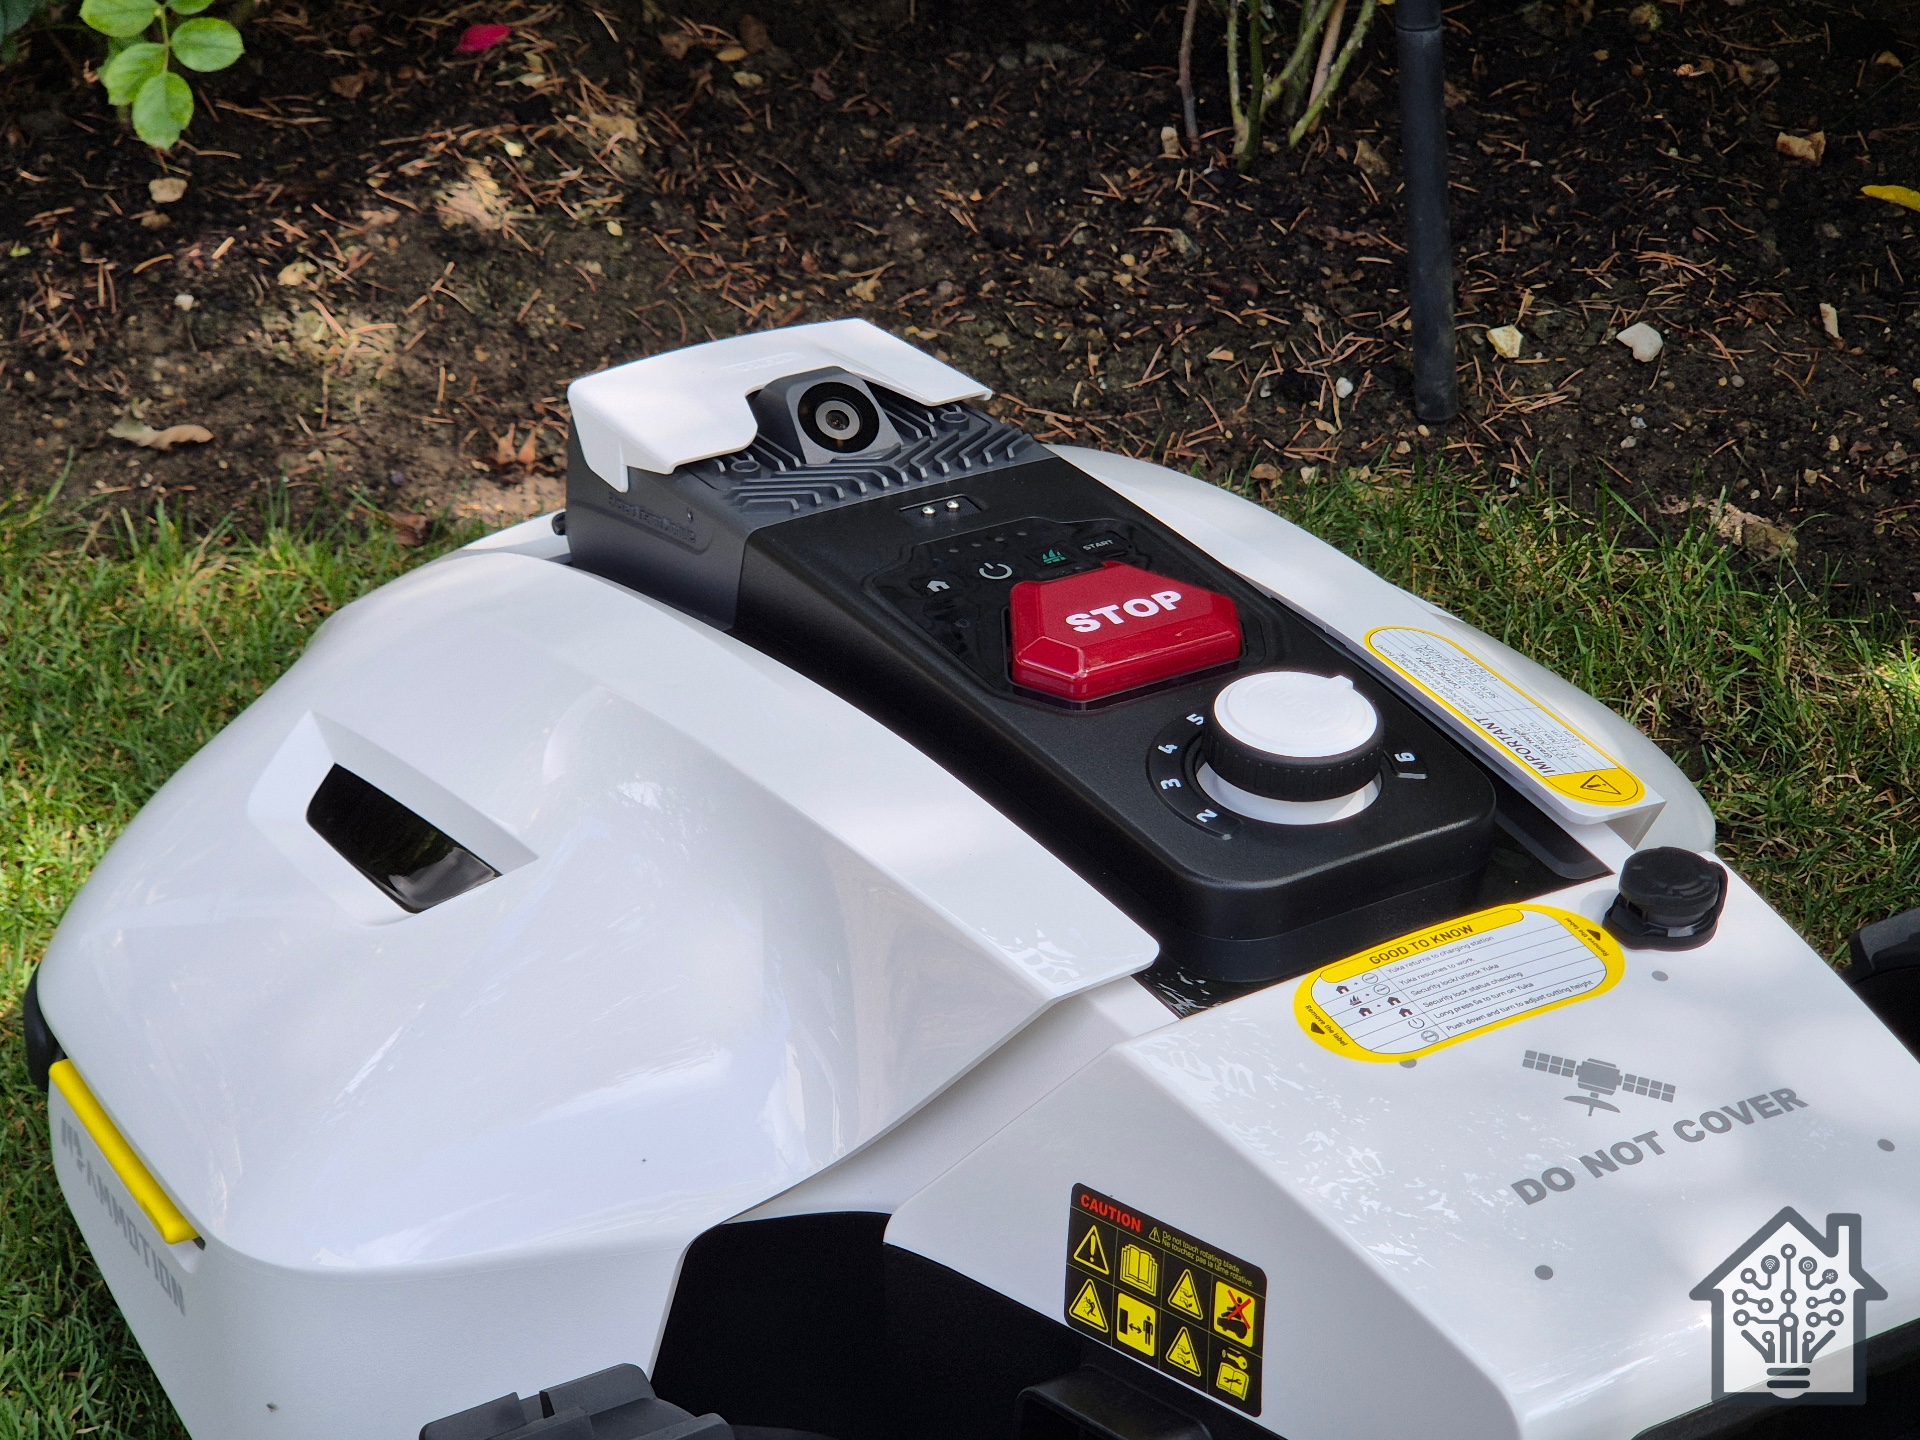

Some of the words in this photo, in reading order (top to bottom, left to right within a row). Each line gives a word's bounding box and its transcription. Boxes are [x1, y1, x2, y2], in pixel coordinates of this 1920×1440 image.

[1082, 538, 1114, 552] START
[1065, 589, 1182, 634] STOP
[1415, 657, 1438, 672] Height
[1436, 671, 1462, 689] Cutting
[1186, 713, 1205, 726] 5
[1510, 727, 1535, 744] Height
[1157, 743, 1178, 755] 4
[1473, 717, 1556, 774] IMPORTANT
[1533, 744, 1553, 758] Grass
[1160, 778, 1182, 790] 3
[1196, 809, 1218, 823] 2
[1564, 918, 1579, 929] label
[1369, 946, 1409, 964] GOOD
[1409, 939, 1430, 950] TO
[1429, 924, 1473, 944] KNOW
[1386, 965, 1406, 973] Yuka
[1405, 956, 1432, 968] returns
[1439, 943, 1471, 956] charging
[1470, 936, 1494, 946] station
[1588, 938, 1609, 956] Remove
[1399, 977, 1418, 985] Yuka
[1417, 966, 1448, 980] resumes
[1457, 957, 1475, 966] work
[1410, 983, 1441, 996] Security
[1440, 969, 1482, 986] lock/unlock
[1480, 964, 1500, 972] Yuka
[1422, 995, 1454, 1008] Security
[1452, 989, 1468, 998] lock
[1468, 982, 1491, 992] status
[1490, 972, 1524, 985] checking
[1433, 1009, 1455, 1019] Long
[1453, 1002, 1474, 1013] press
[1490, 991, 1507, 999] turn
[1515, 982, 1534, 991] Yuka
[1445, 1022, 1466, 1031] Push
[1465, 1014, 1487, 1025] down
[1486, 1009, 1501, 1018] and
[1499, 1004, 1516, 1013] turn
[1524, 994, 1546, 1005] adjust
[1545, 987, 1574, 998] cutting
[1569, 980, 1594, 990] height
[1305, 1005, 1325, 1024] Remove
[1324, 1024, 1334, 1033] the
[1333, 1033, 1348, 1046] label
[1510, 1167, 1576, 1205] DO
[1578, 1130, 1666, 1179] NOT
[1672, 1087, 1809, 1143] COVER
[1080, 1193, 1142, 1232] CAUTION
[1162, 1231, 1171, 1240] Do
[1172, 1237, 1182, 1246] not
[1183, 1241, 1198, 1253] touch
[1200, 1250, 1222, 1266] rotating
[1162, 1239, 1171, 1247] Ne
[1172, 1243, 1194, 1259] touchez
[1196, 1255, 1207, 1265] pas
[1207, 1260, 1214, 1268] la
[1230, 1271, 1254, 1287] rotative.
